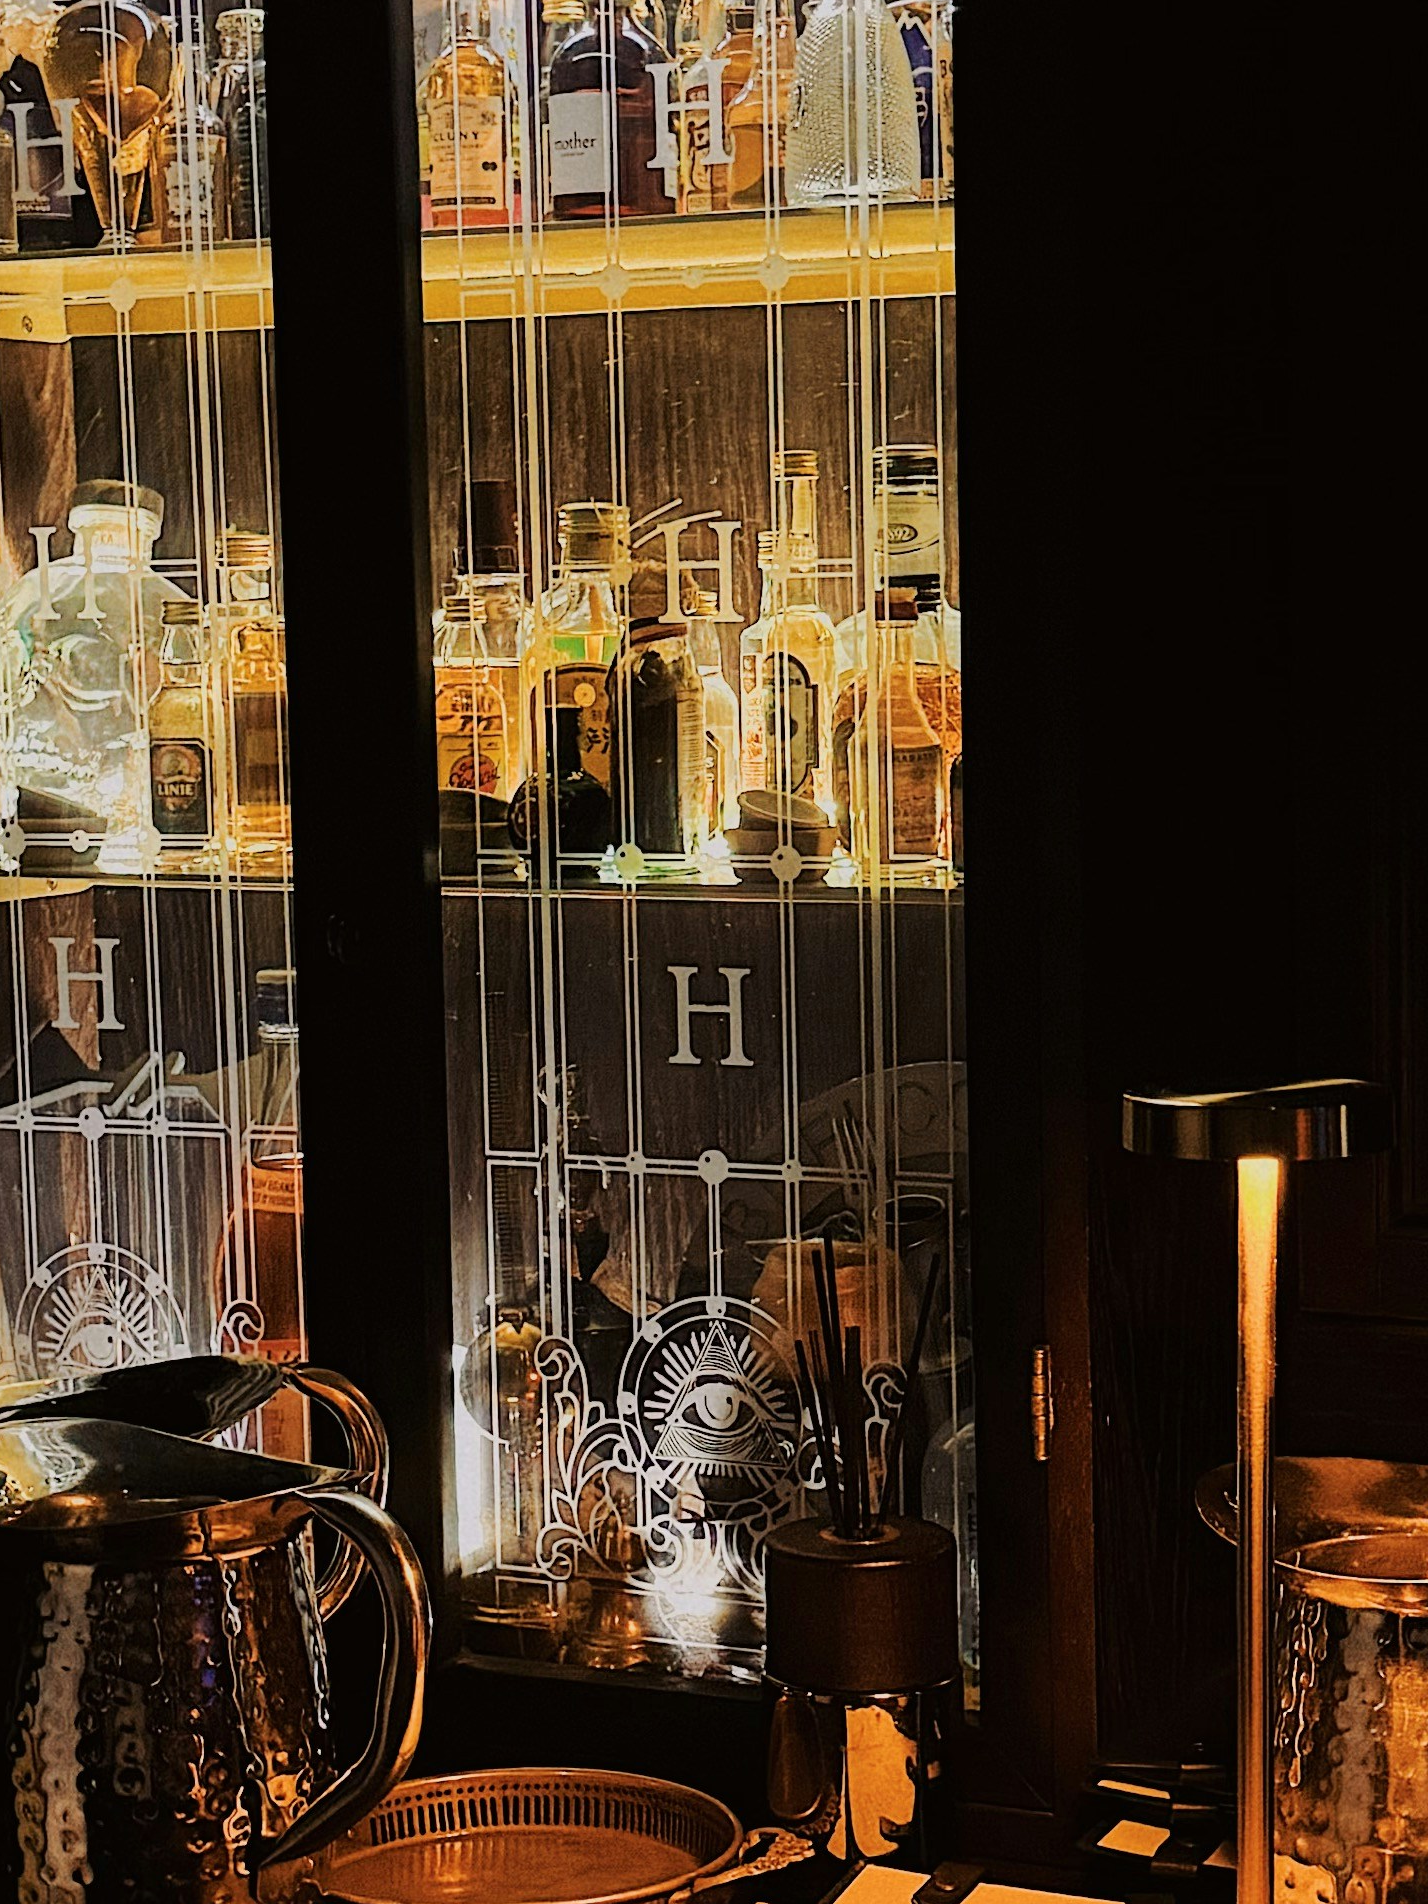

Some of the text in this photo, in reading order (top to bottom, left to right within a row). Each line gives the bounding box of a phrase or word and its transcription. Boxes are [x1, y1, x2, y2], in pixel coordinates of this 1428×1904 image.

[5, 98, 87, 200] H
[645, 58, 735, 169] H
[657, 520, 745, 624] H
[157, 783, 194, 796] LINIE
[48, 937, 126, 1031] H
[666, 965, 754, 1067] H
